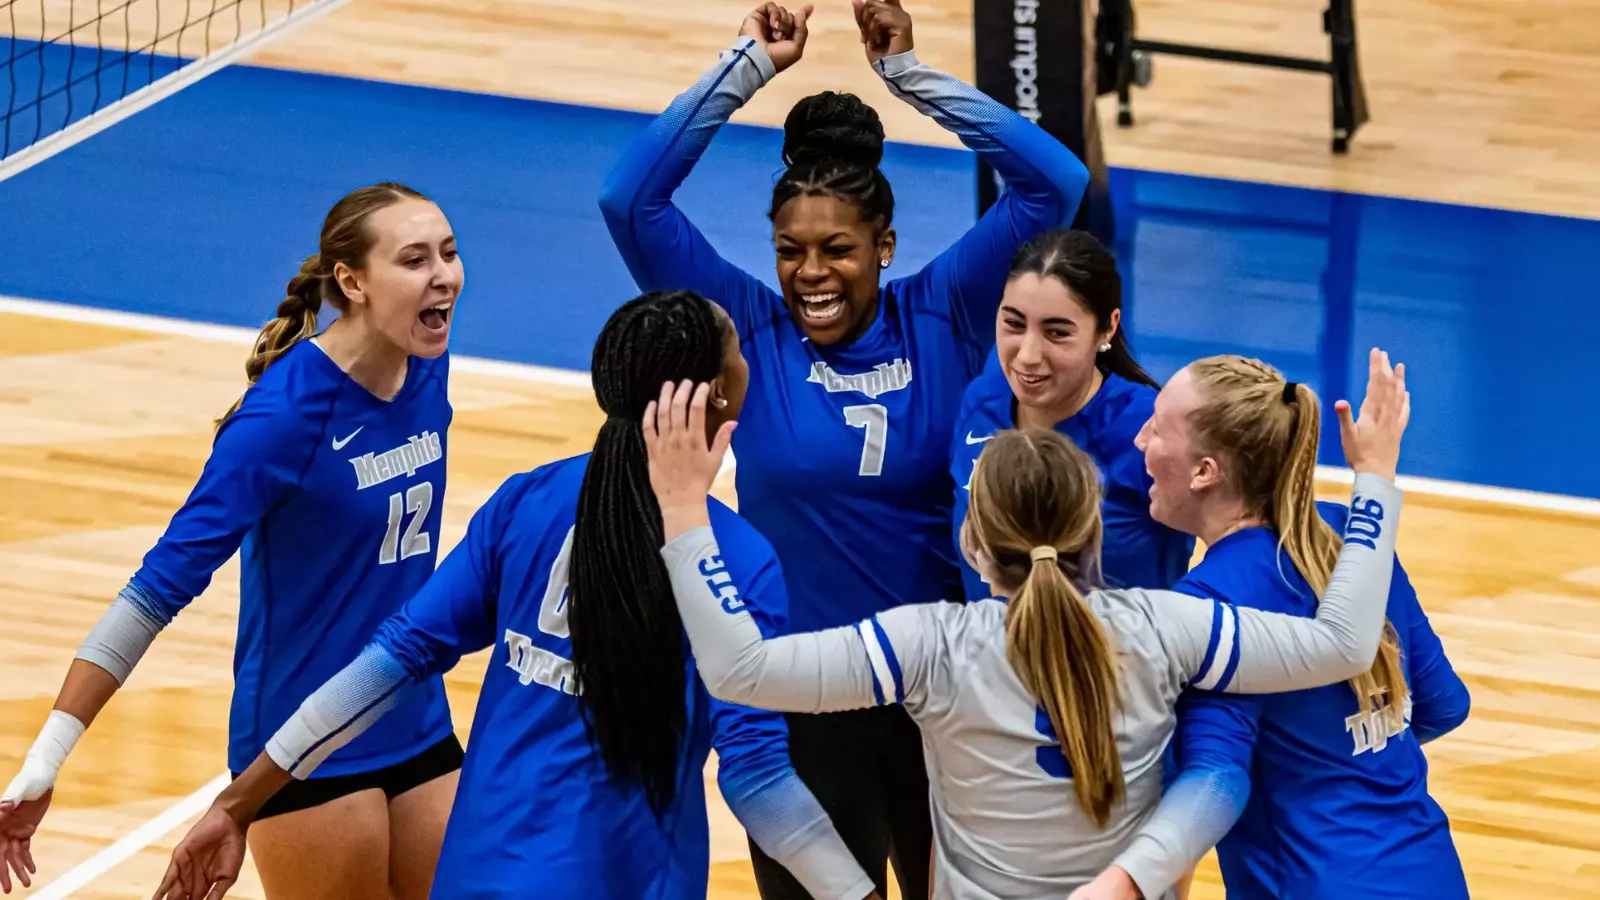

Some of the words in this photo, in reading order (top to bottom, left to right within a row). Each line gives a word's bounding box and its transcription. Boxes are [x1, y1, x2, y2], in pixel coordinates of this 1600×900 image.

[806, 358, 912, 399] Memphis
[348, 430, 442, 490] Memphis
[843, 403, 888, 476] 7
[379, 481, 433, 565] 12
[1344, 496, 1384, 551] 901
